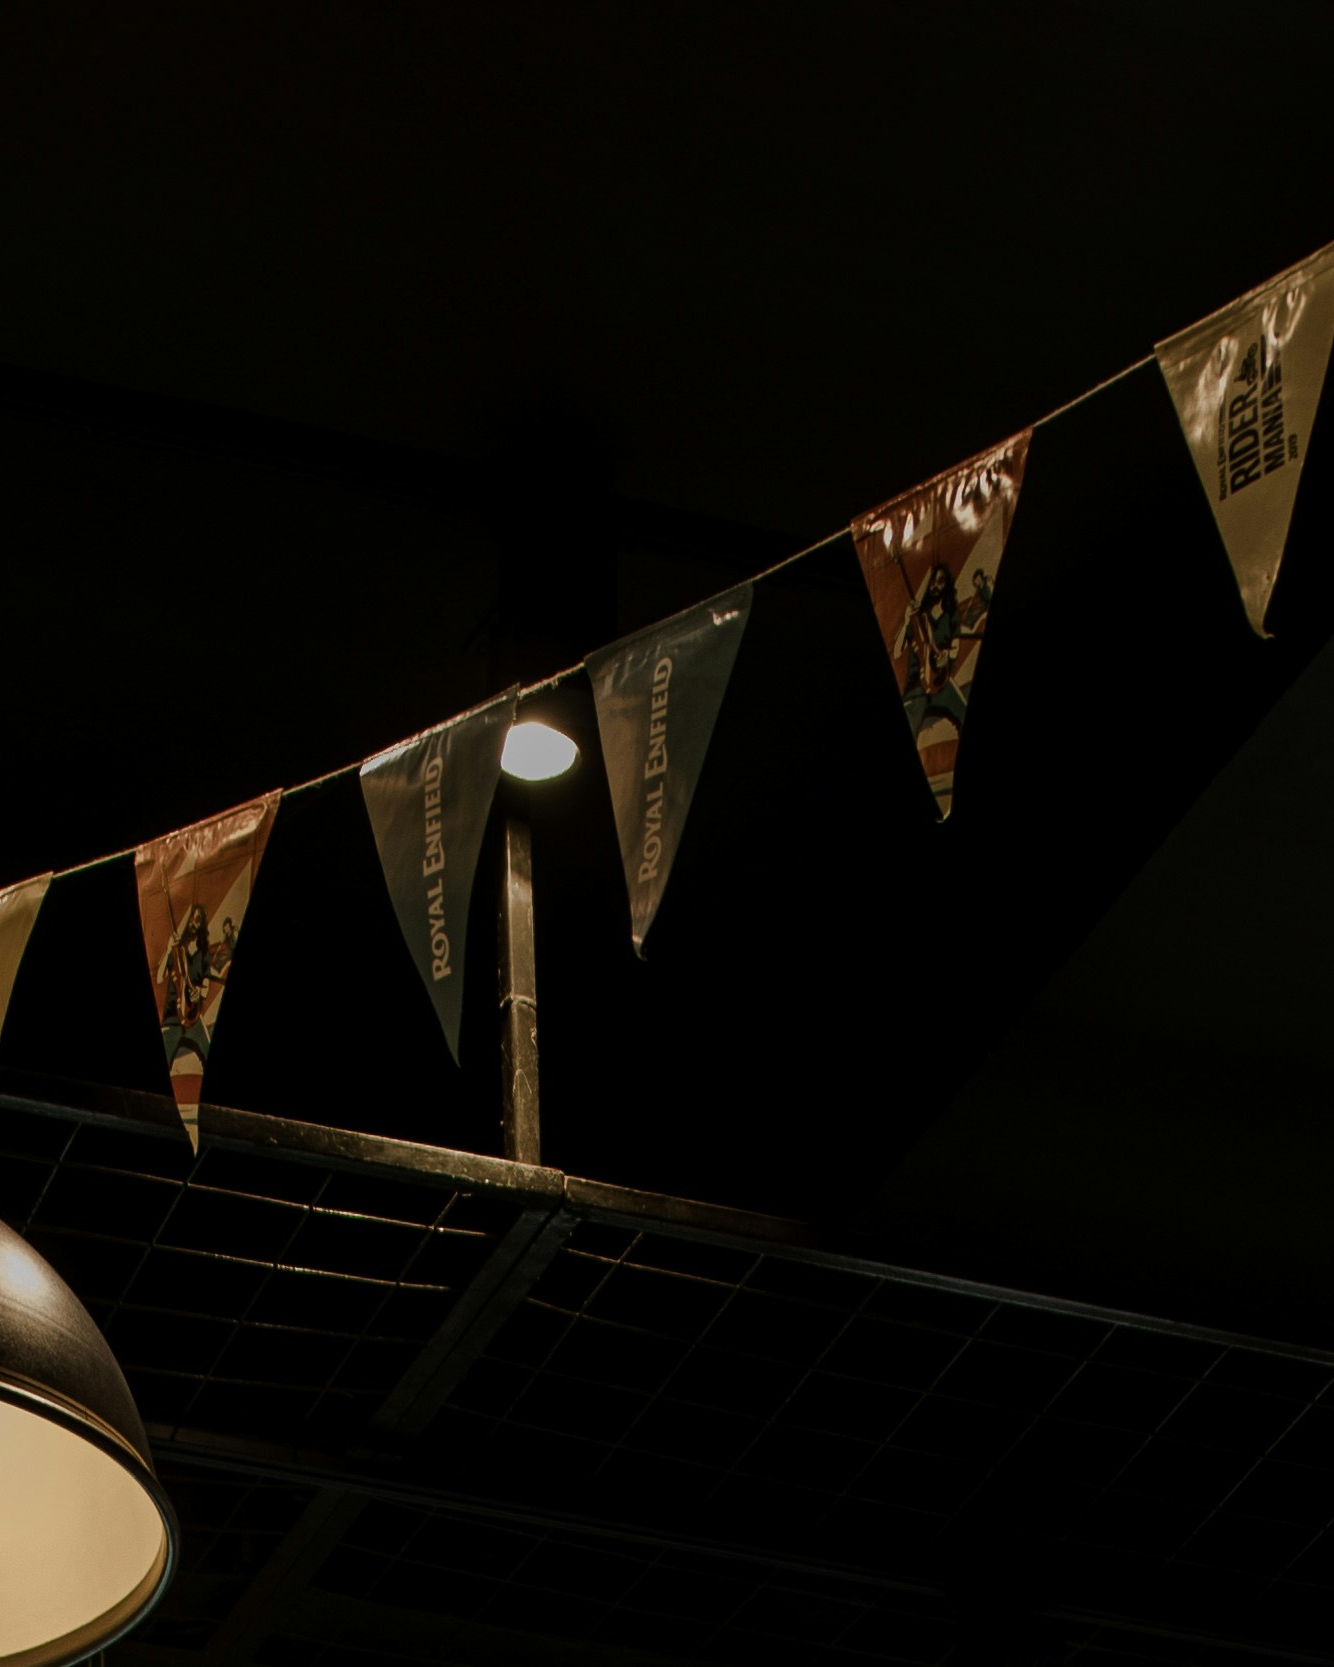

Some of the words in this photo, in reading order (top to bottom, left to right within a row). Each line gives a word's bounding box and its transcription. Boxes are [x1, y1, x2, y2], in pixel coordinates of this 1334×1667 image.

[1228, 382, 1261, 495] RIDER
[1261, 386, 1285, 475] MANIA
[644, 657, 673, 781] ENFIELD
[423, 756, 445, 877] ENFIELD
[638, 781, 664, 884] ROYAL
[428, 878, 452, 982] ROYAL
